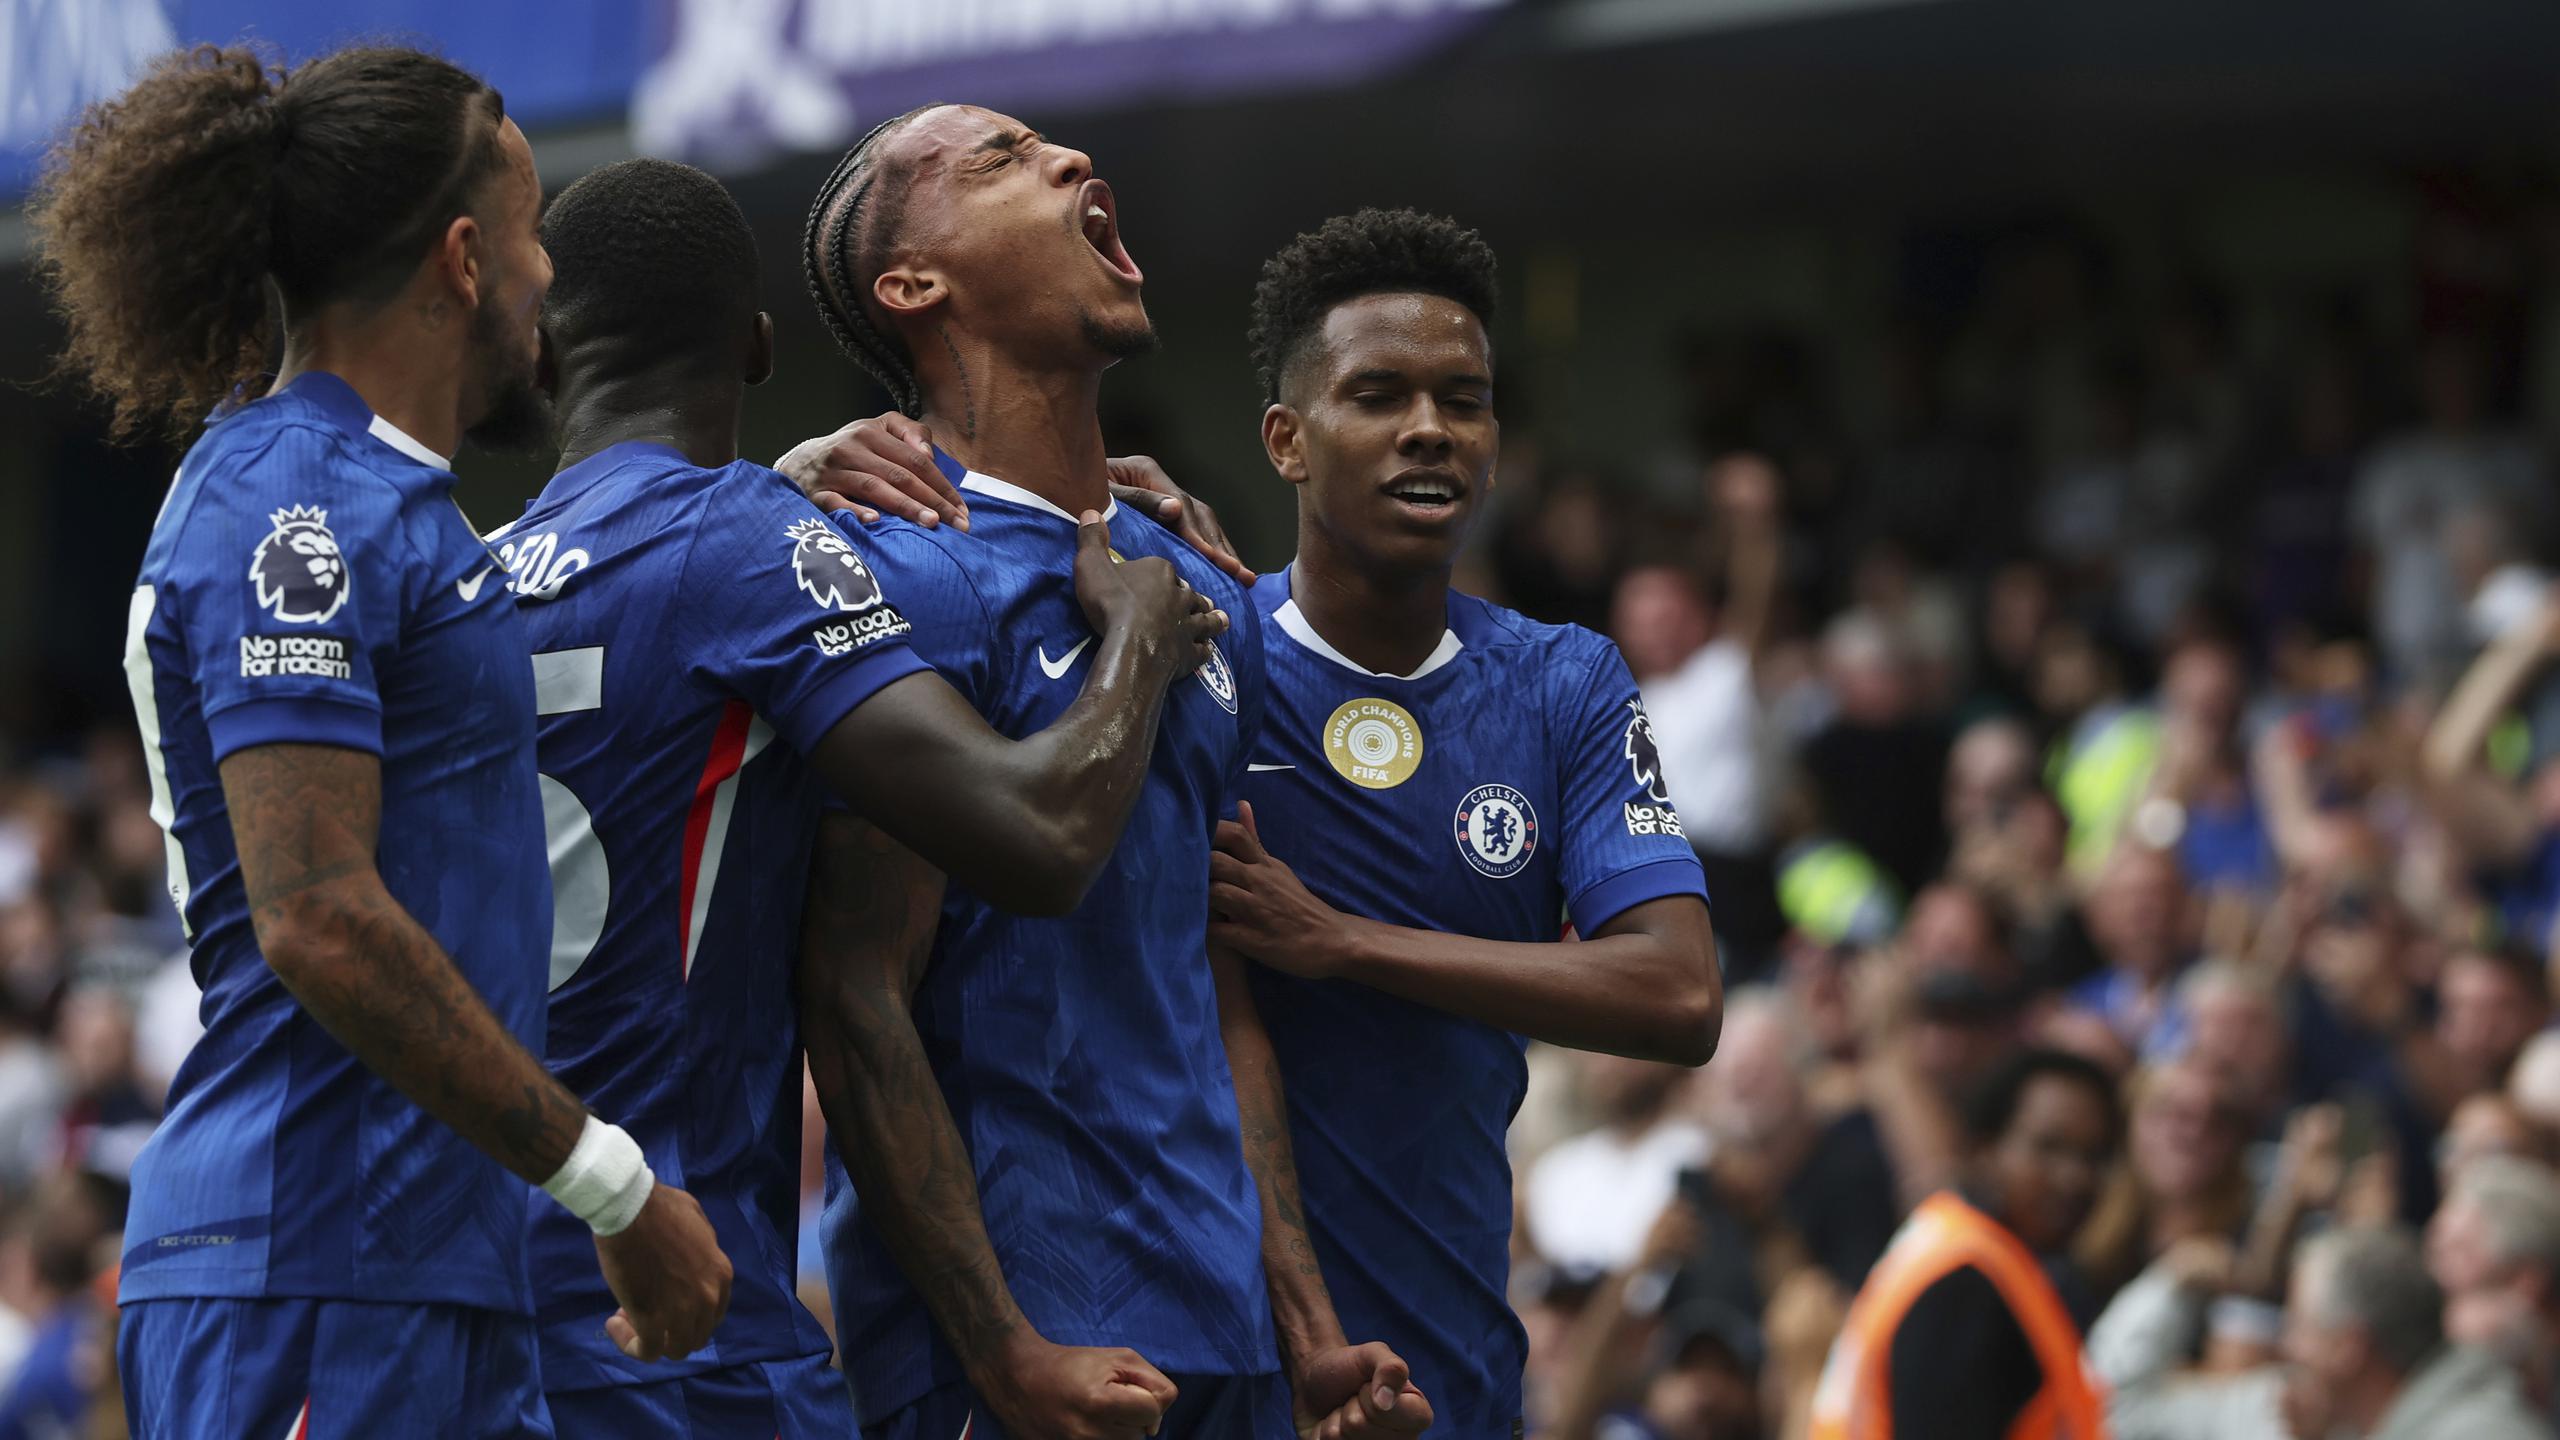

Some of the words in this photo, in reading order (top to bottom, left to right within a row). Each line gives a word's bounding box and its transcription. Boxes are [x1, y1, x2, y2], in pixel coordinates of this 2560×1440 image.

[500, 532, 589, 600] EDO
[240, 635, 278, 658] No
[280, 637, 344, 659] room
[813, 625, 850, 652] No
[240, 655, 277, 678] for
[278, 656, 351, 679] racism
[1332, 709, 1360, 749] WORLD
[1361, 705, 1415, 759] CHAMPIONS
[1352, 765, 1389, 782] FIFA
[1470, 787, 1526, 811] CHELSEA
[1624, 802, 1654, 821] No
[1626, 820, 1658, 836] for
[1468, 852, 1503, 874] FOOTBALL
[1504, 859, 1522, 873] CLUB
